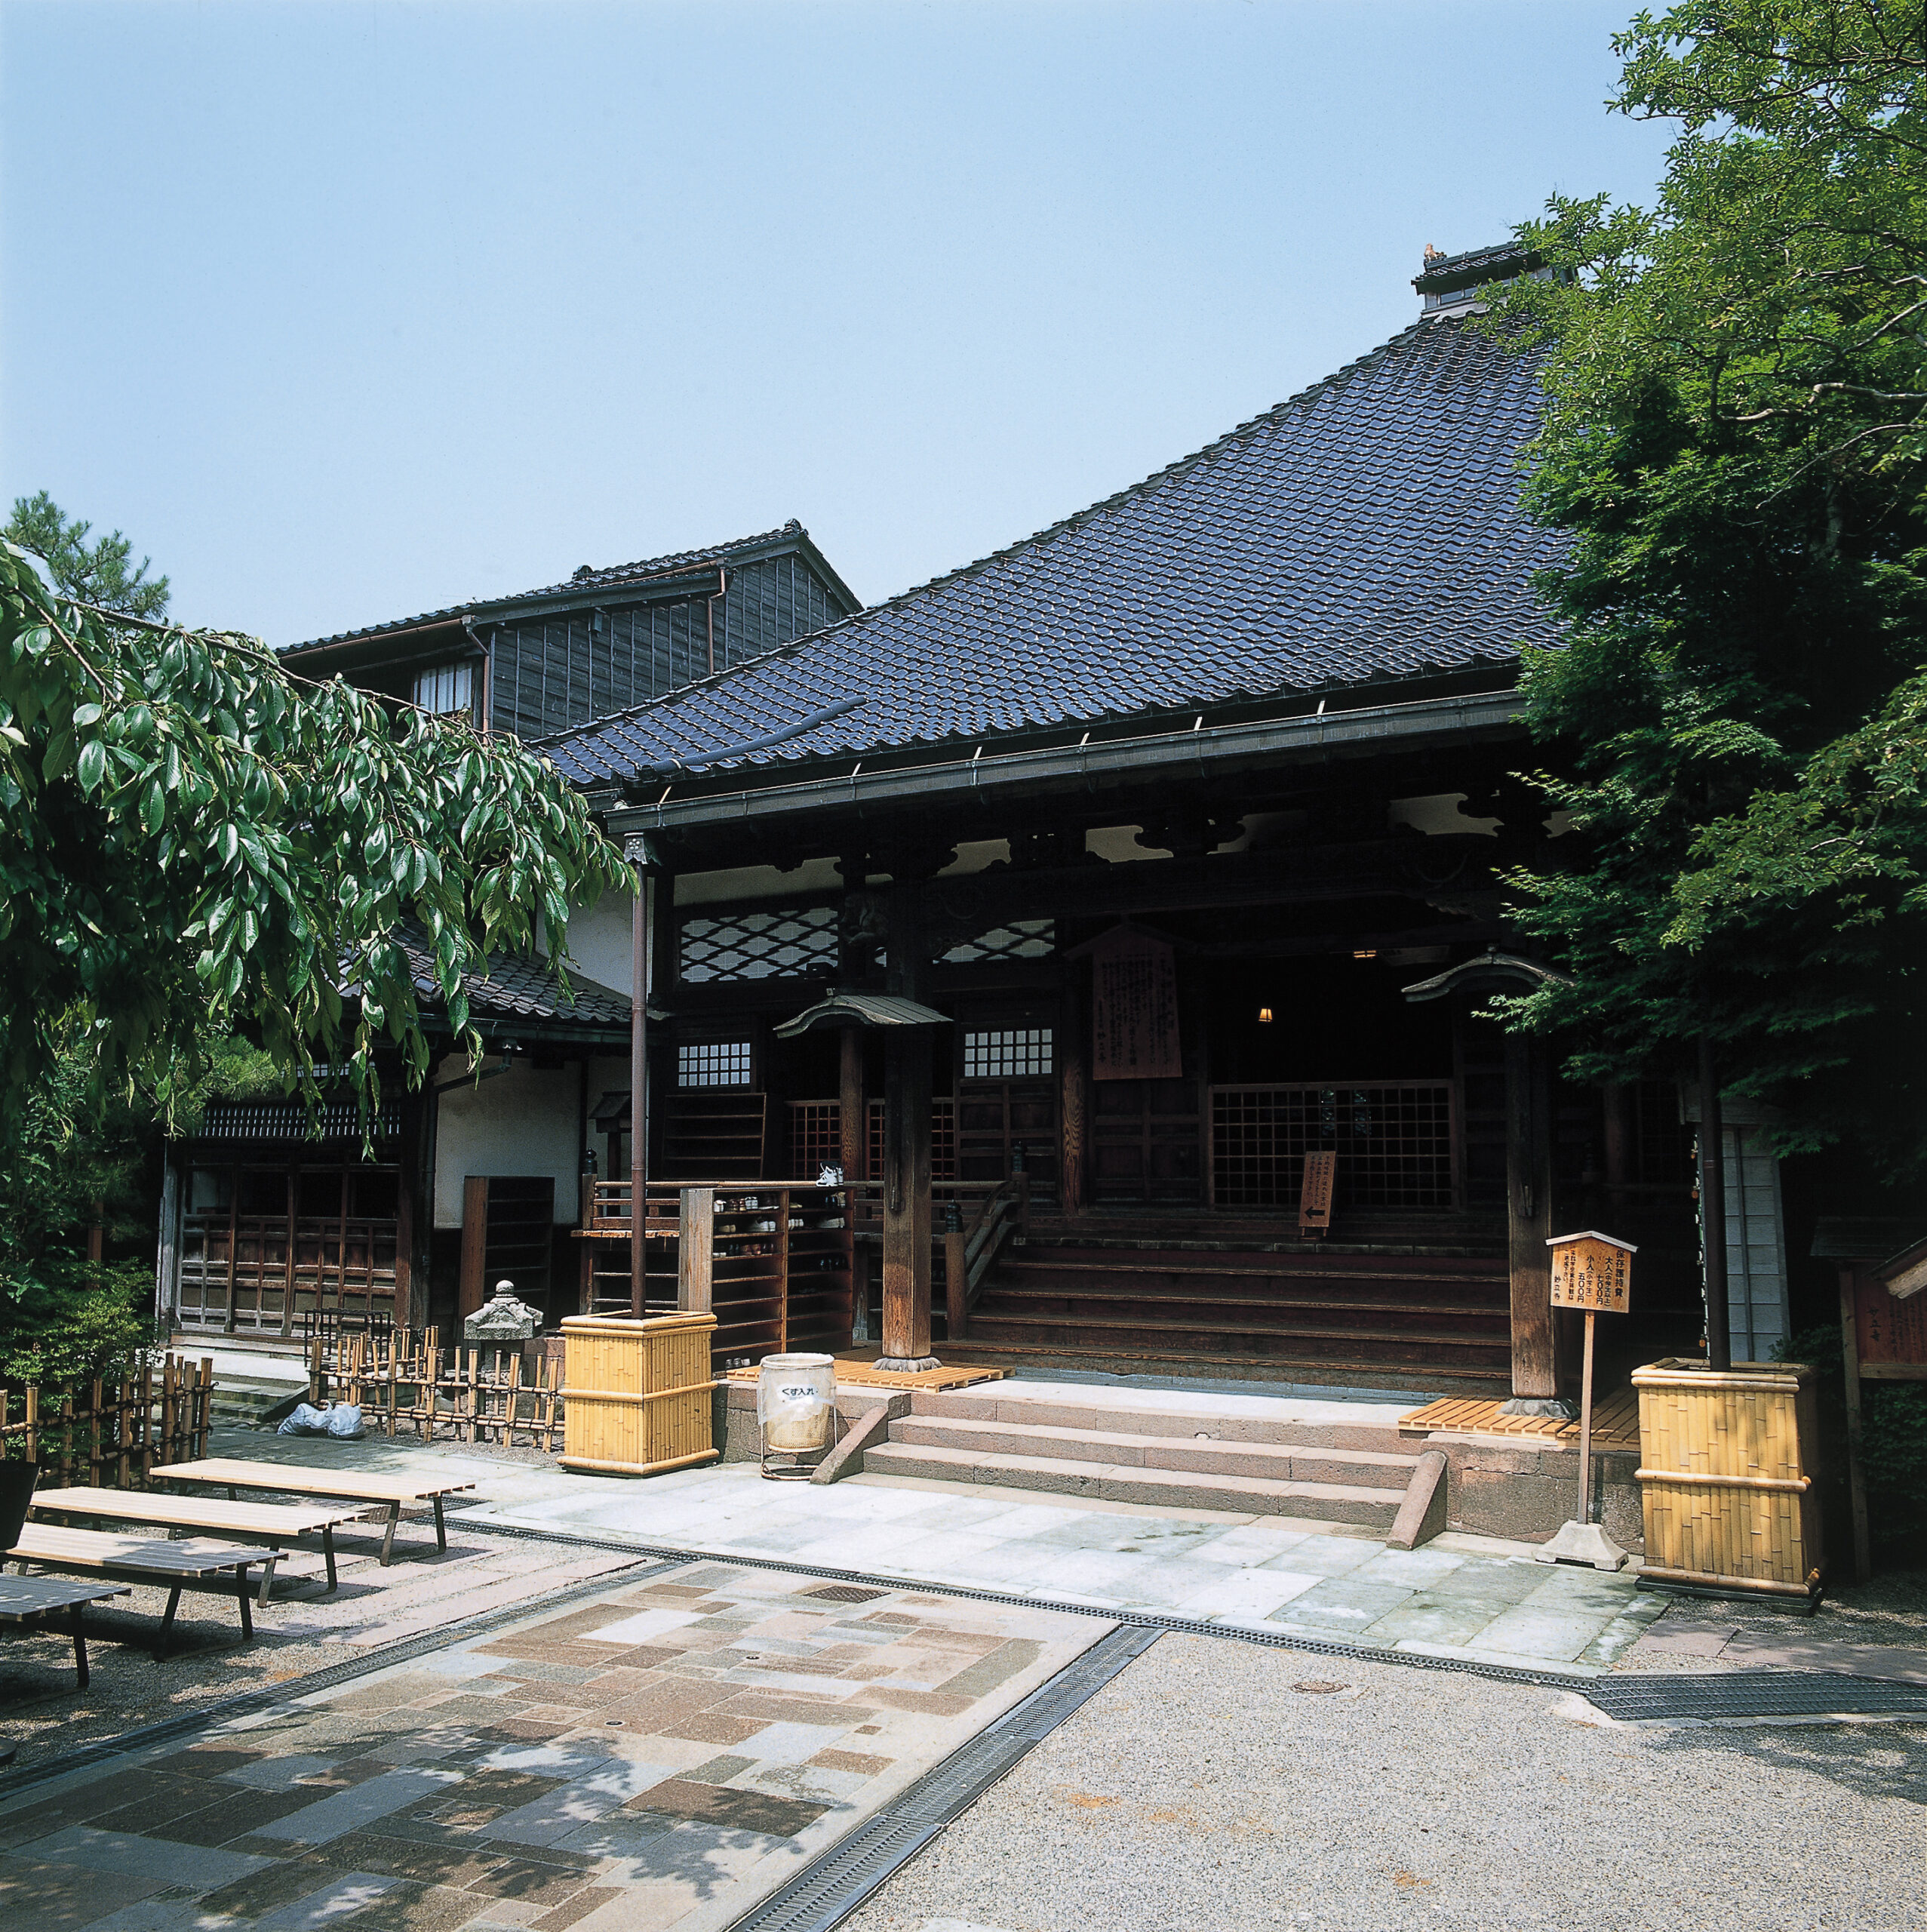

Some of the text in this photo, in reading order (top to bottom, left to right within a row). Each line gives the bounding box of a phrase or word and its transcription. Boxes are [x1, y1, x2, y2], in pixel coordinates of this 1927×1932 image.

[1615, 1250, 1625, 1297] 保存護持費
[1866, 1306, 1881, 1342] 妙立寺
